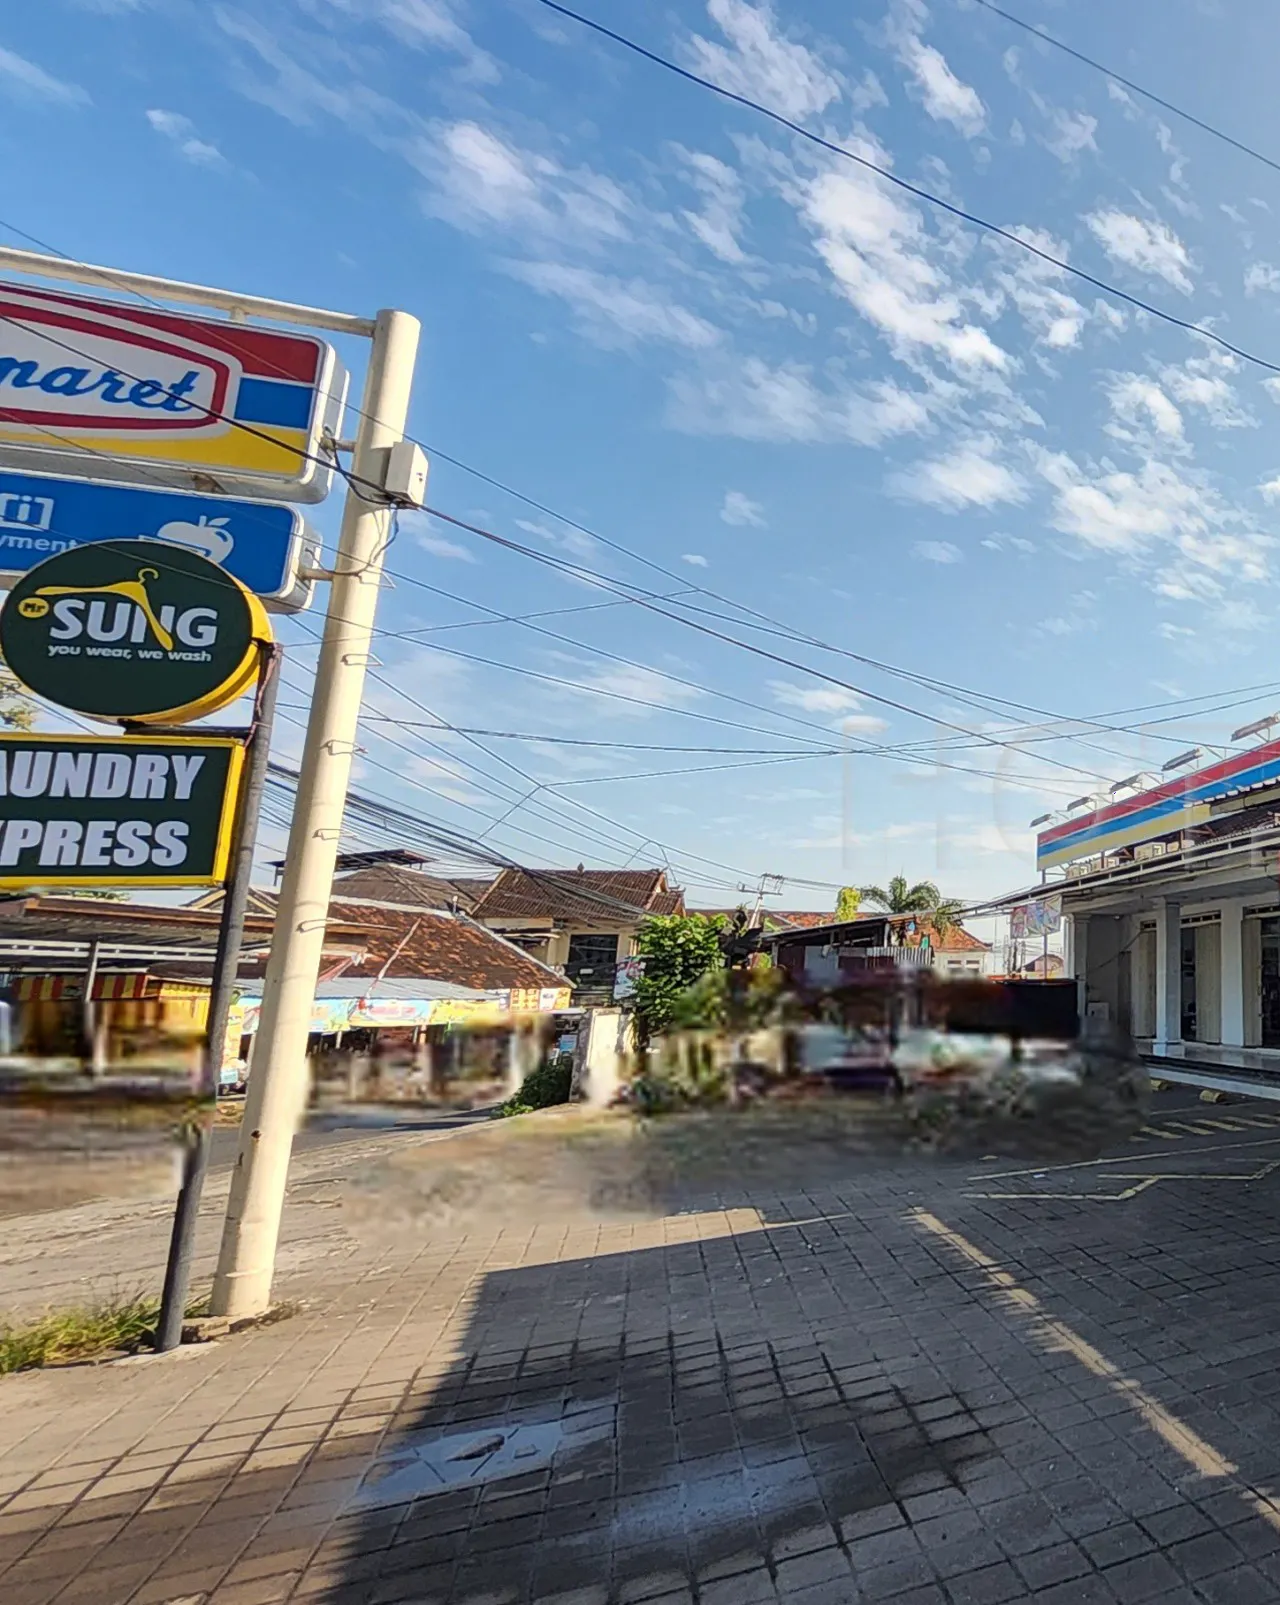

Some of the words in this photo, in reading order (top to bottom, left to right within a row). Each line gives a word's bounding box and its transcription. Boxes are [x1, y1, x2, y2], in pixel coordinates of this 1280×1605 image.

[50, 599, 218, 647] SUNG
[48, 644, 81, 657] you
[86, 646, 133, 660] wear,
[138, 649, 164, 660] we
[167, 649, 212, 662] wash
[0, 750, 206, 800] UNDRY
[0, 819, 190, 867] PRESS
